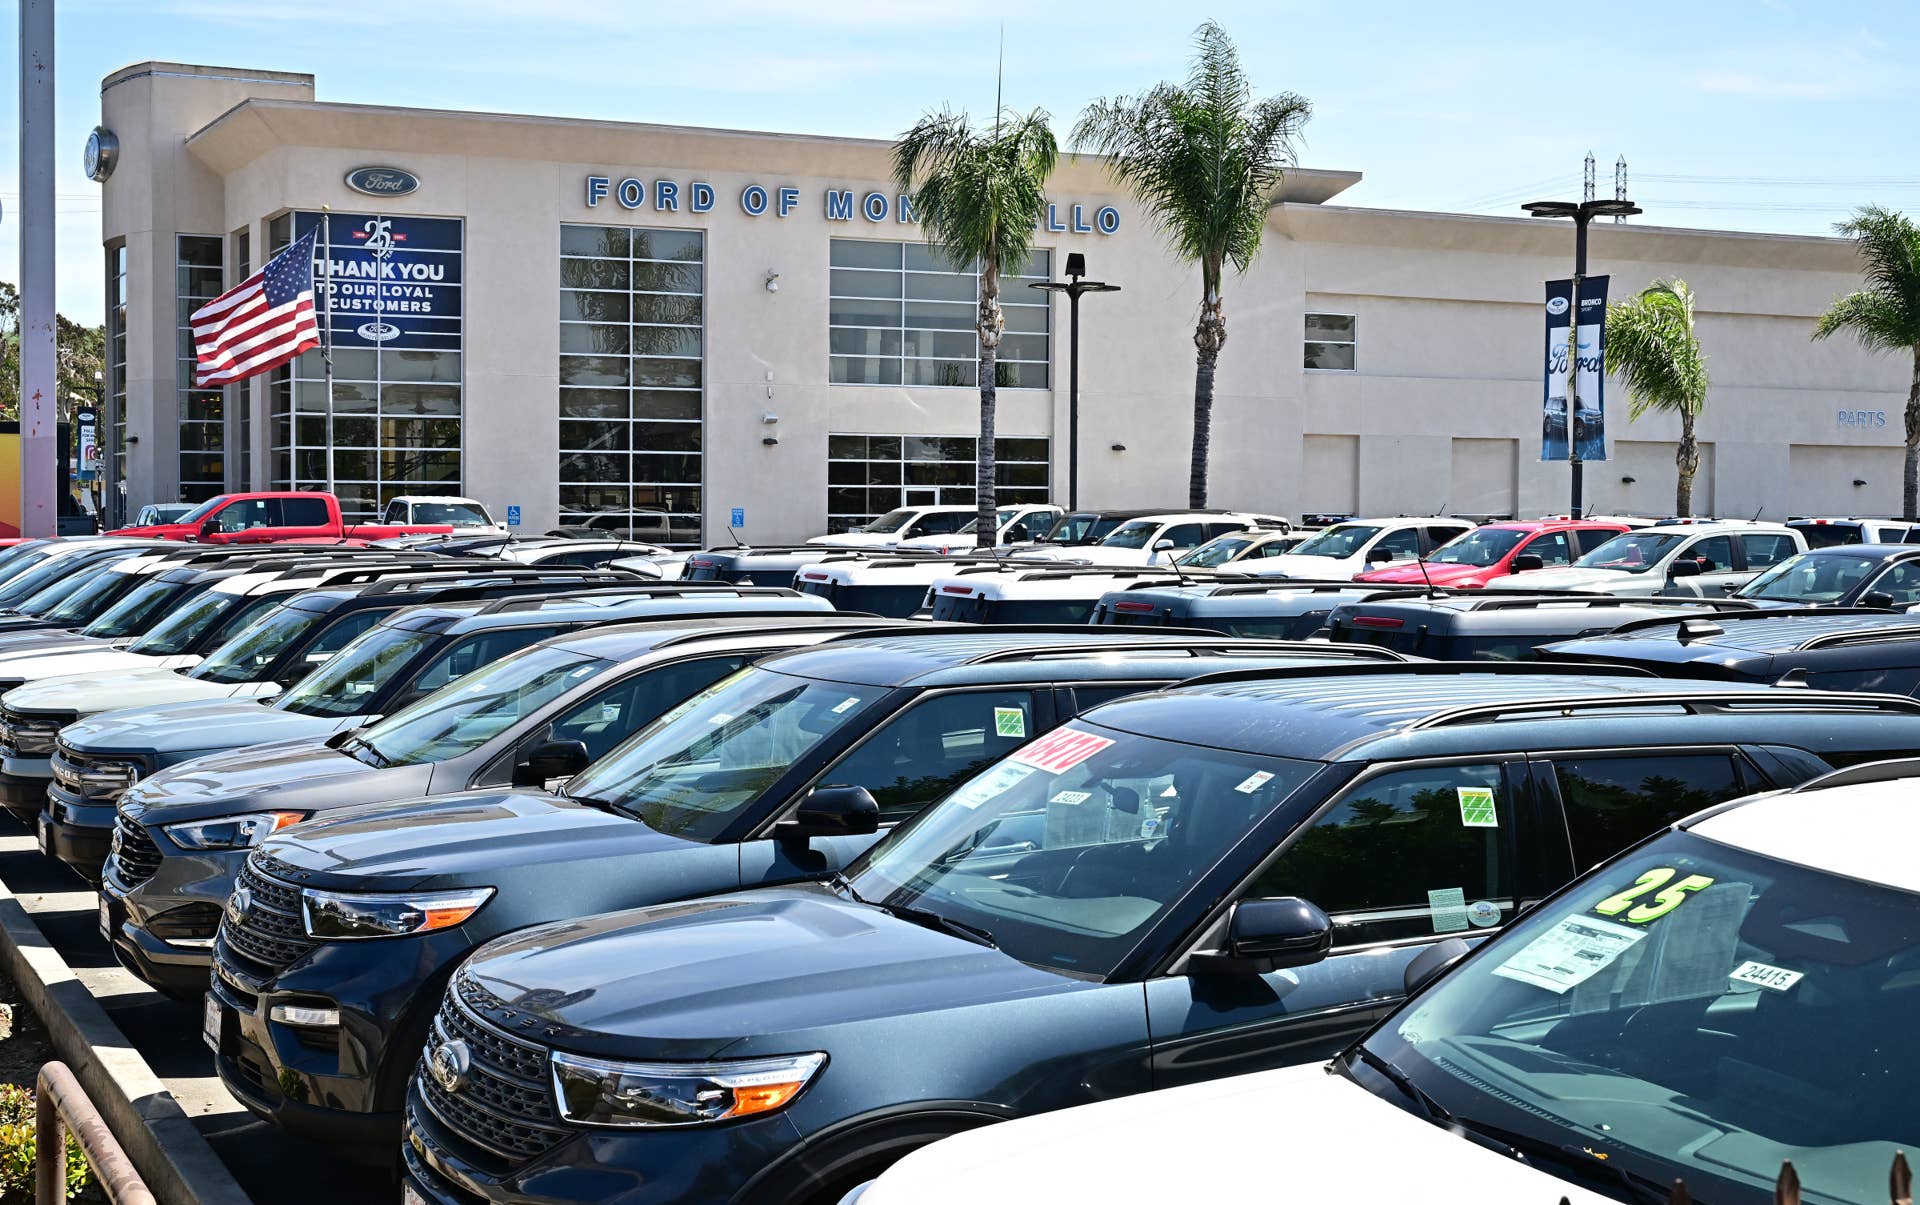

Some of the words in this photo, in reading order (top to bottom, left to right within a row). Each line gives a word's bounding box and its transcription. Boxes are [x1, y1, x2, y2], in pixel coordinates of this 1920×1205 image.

[365, 173, 403, 190] Ford
[587, 176, 716, 213] FORD
[741, 184, 800, 217] OF
[826, 189, 1122, 236] MONLLO
[364, 220, 392, 258] 25
[314, 259, 396, 279] THANK
[398, 263, 444, 281] YOU
[316, 283, 338, 294] TO
[342, 283, 377, 296] OUR
[382, 286, 433, 298] LOYAL
[328, 298, 432, 312] CUSTOMERS
[1581, 298, 1602, 306] BRONCO
[1549, 342, 1604, 375] Ford
[1837, 410, 1887, 427] PARTS
[1595, 867, 1715, 923] 25
[1740, 965, 1792, 985] 24415
